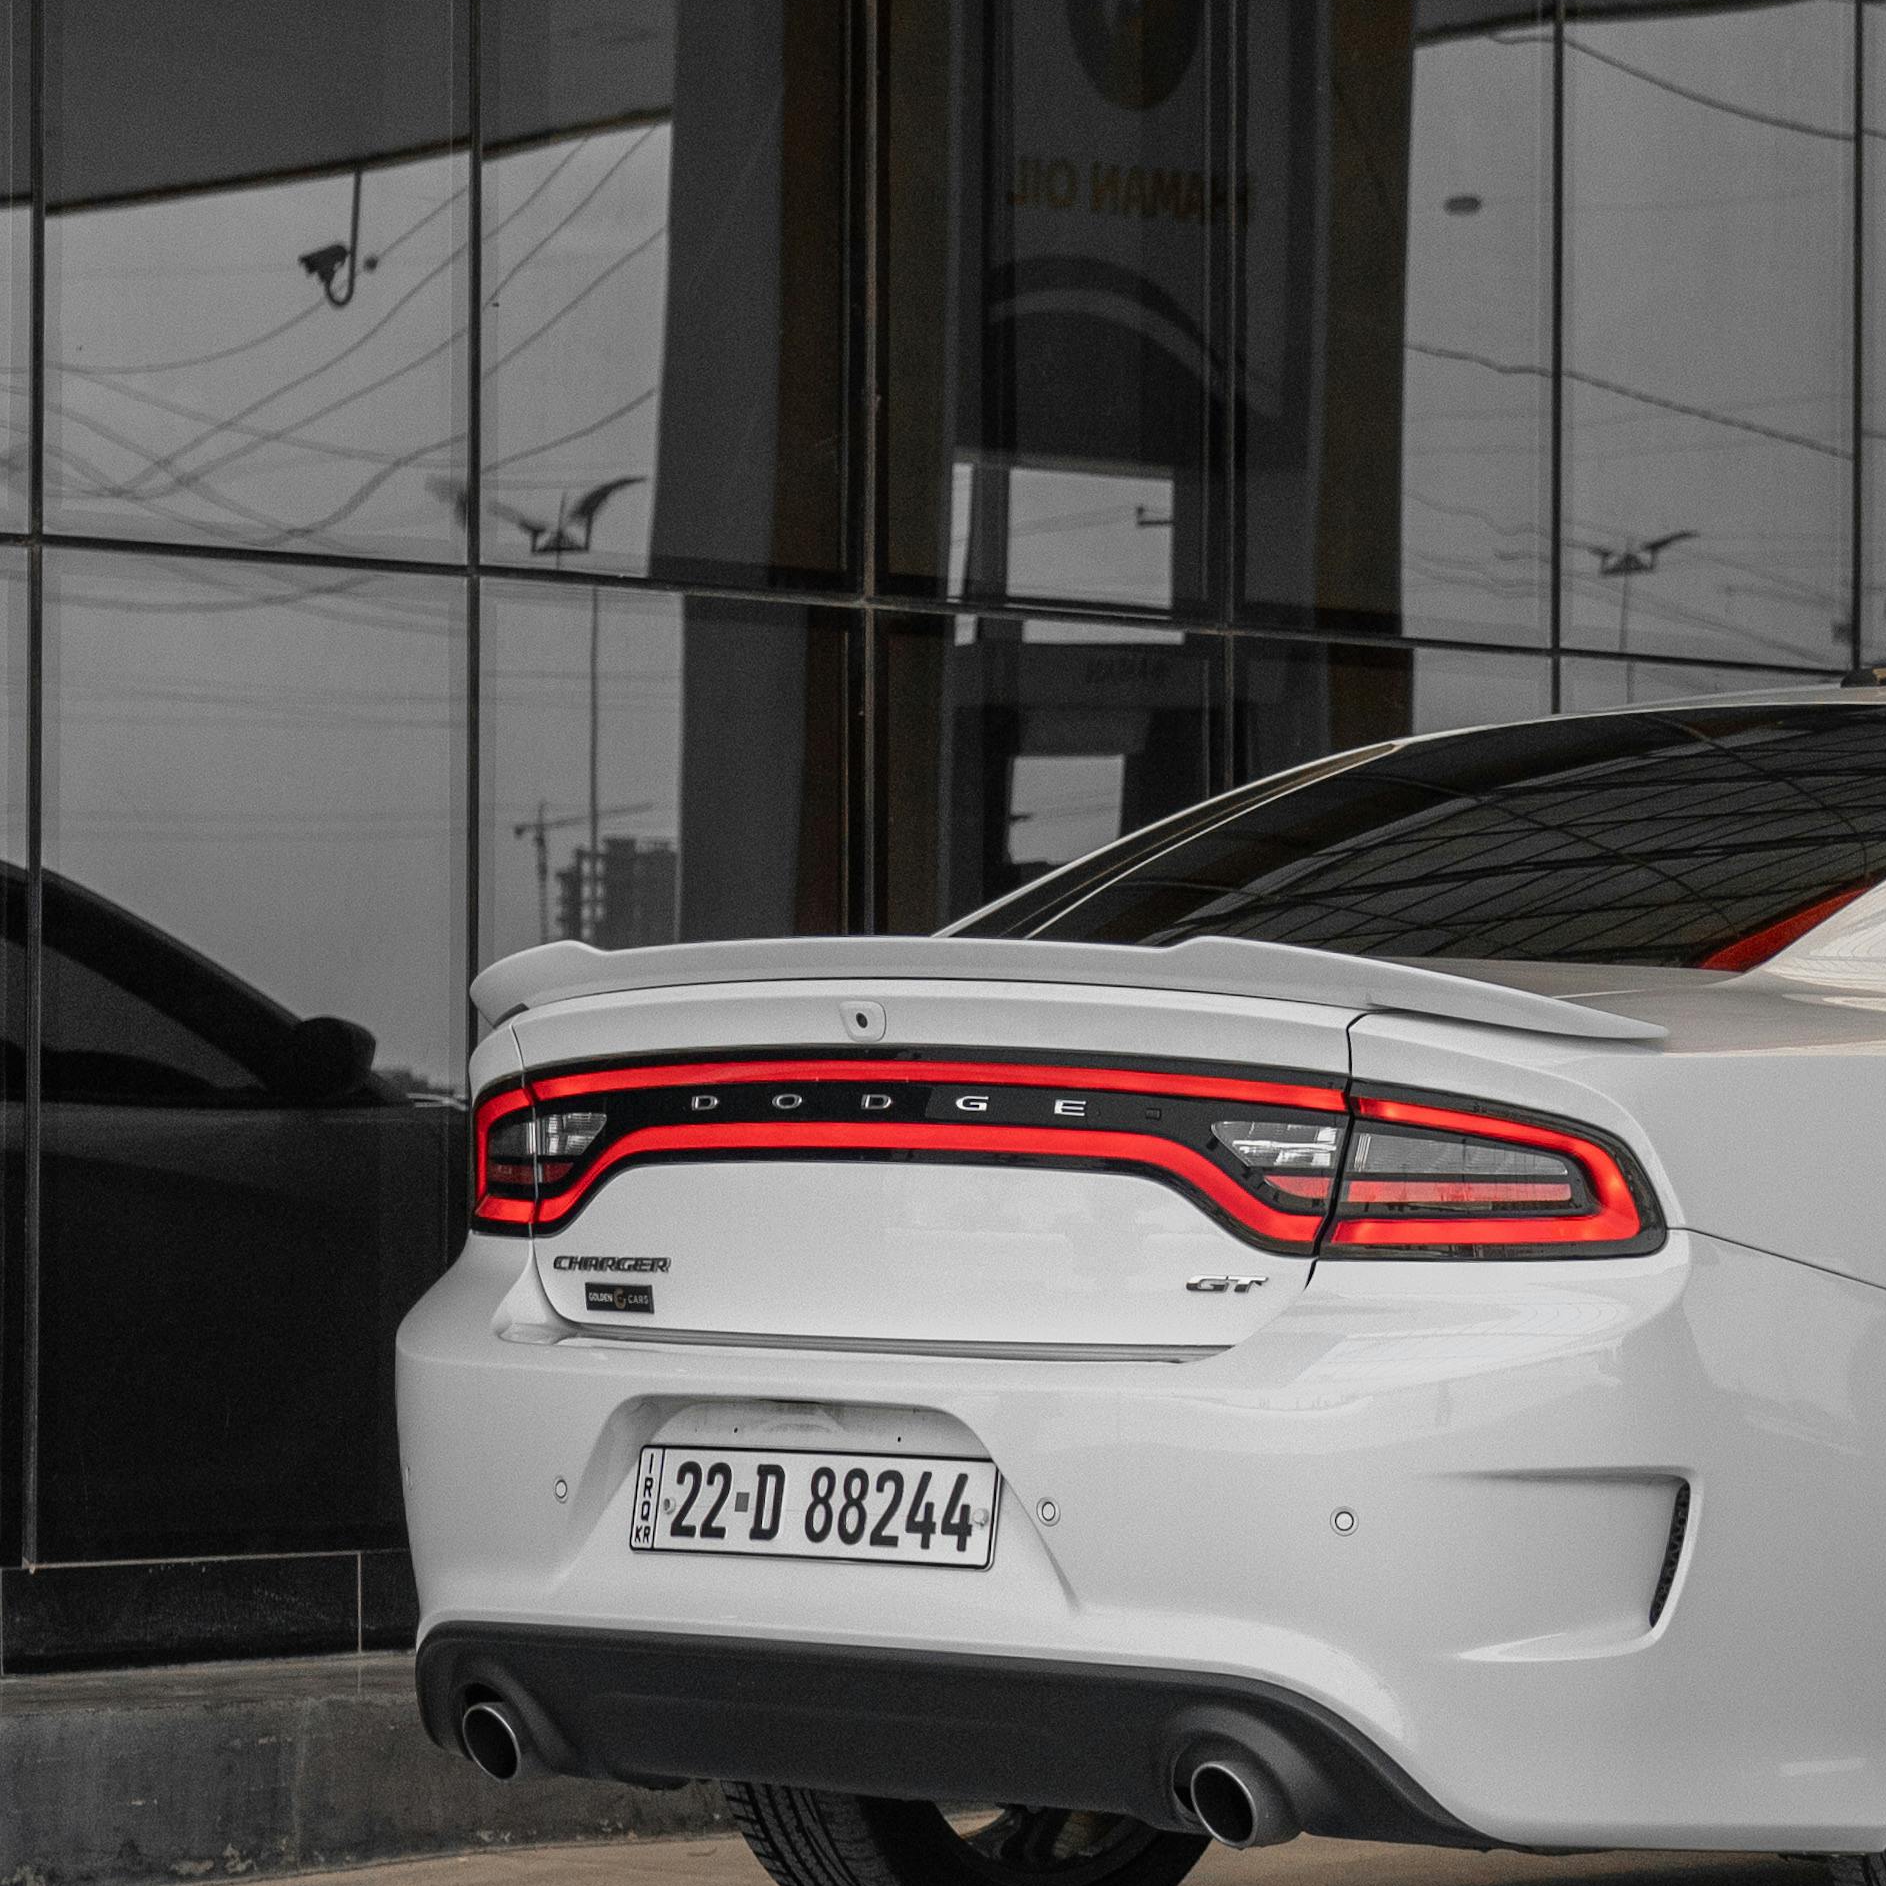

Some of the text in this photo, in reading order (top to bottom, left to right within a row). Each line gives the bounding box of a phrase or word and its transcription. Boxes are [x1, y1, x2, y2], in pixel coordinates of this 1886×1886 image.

[691, 1094, 1088, 1117] DODGE
[553, 1255, 671, 1273] CHARGER
[1185, 1274, 1269, 1293] GT
[589, 1292, 613, 1303] GOLDEN
[628, 1295, 649, 1305] CARS
[804, 1466, 973, 1552] 88244
[635, 1526, 651, 1544] KR
